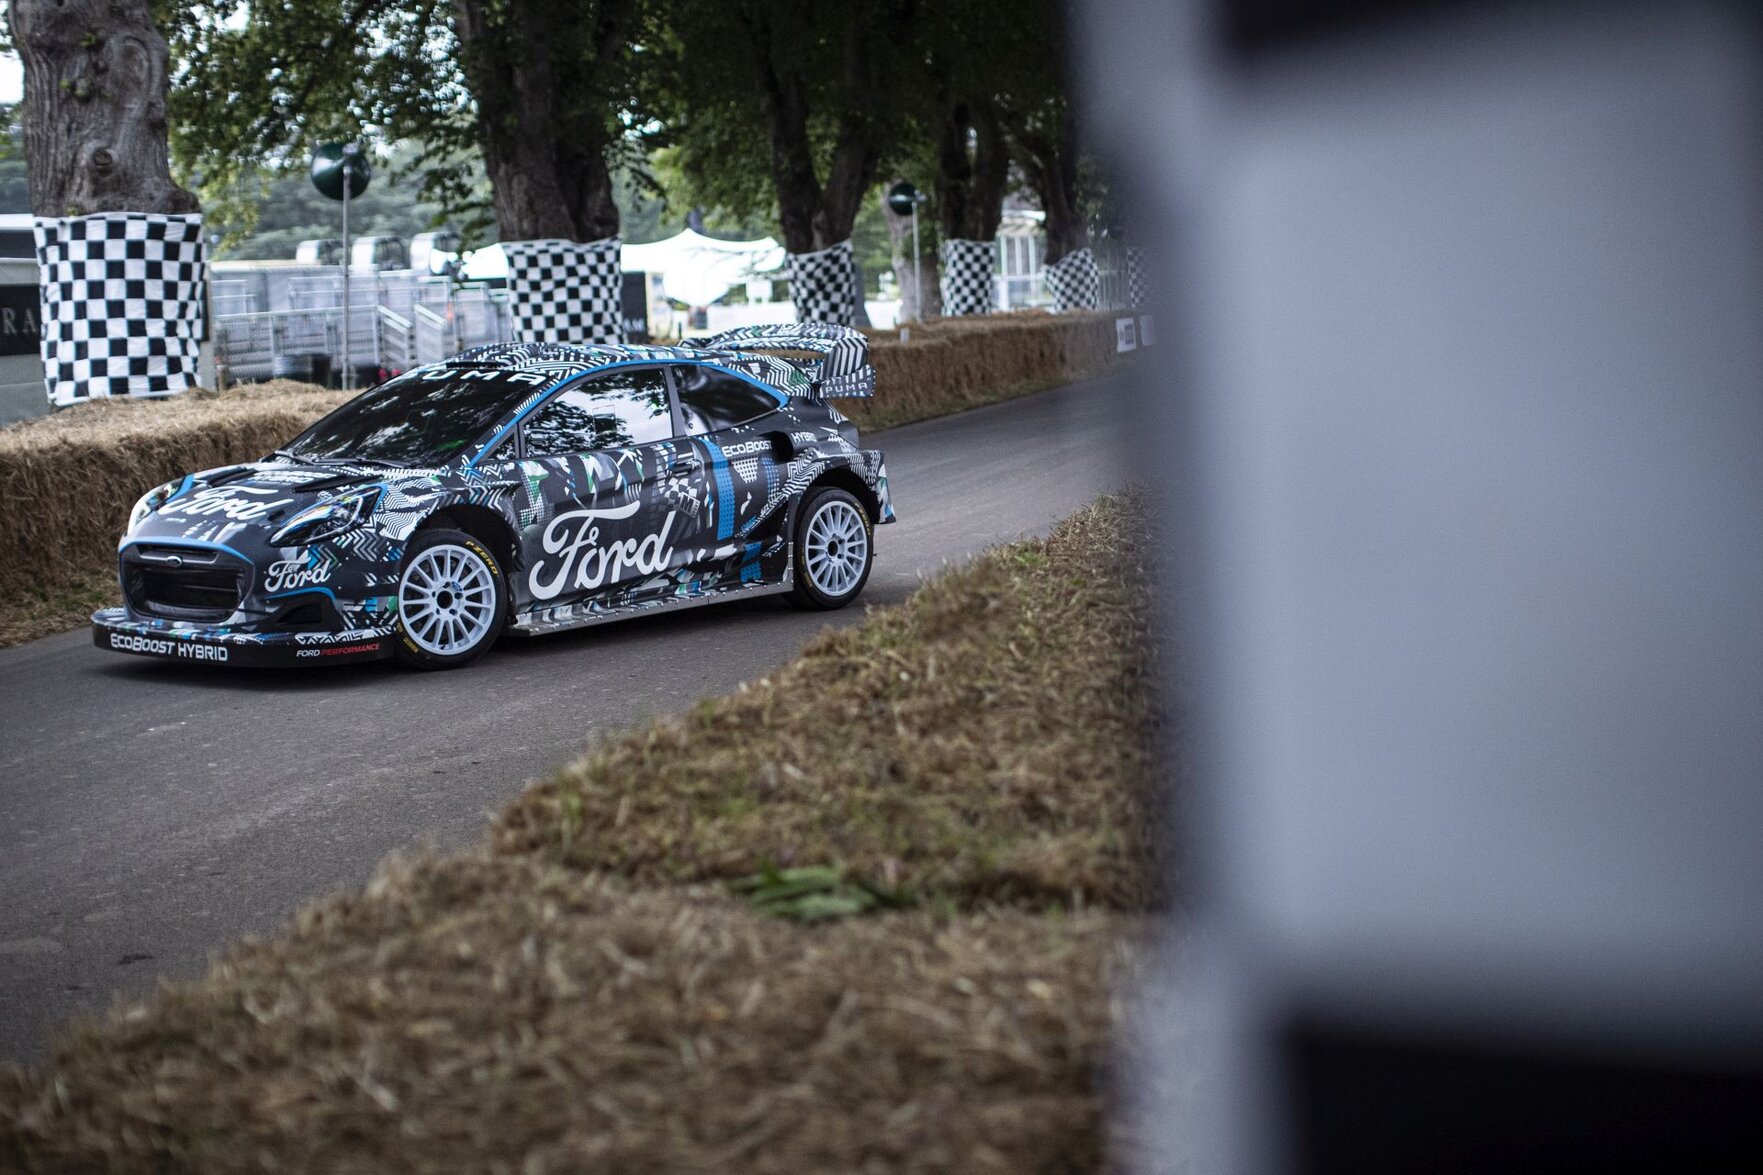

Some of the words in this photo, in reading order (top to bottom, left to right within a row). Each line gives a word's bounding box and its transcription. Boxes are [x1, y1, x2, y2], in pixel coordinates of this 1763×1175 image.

[402, 369, 547, 386] UMA
[825, 382, 868, 394] PUMA
[157, 485, 294, 521] Ford
[528, 500, 677, 600] Ford
[264, 556, 332, 592] Ford
[177, 643, 228, 661] HYBRID
[296, 649, 321, 657] FORD
[321, 643, 380, 656] PERFORMANCE
